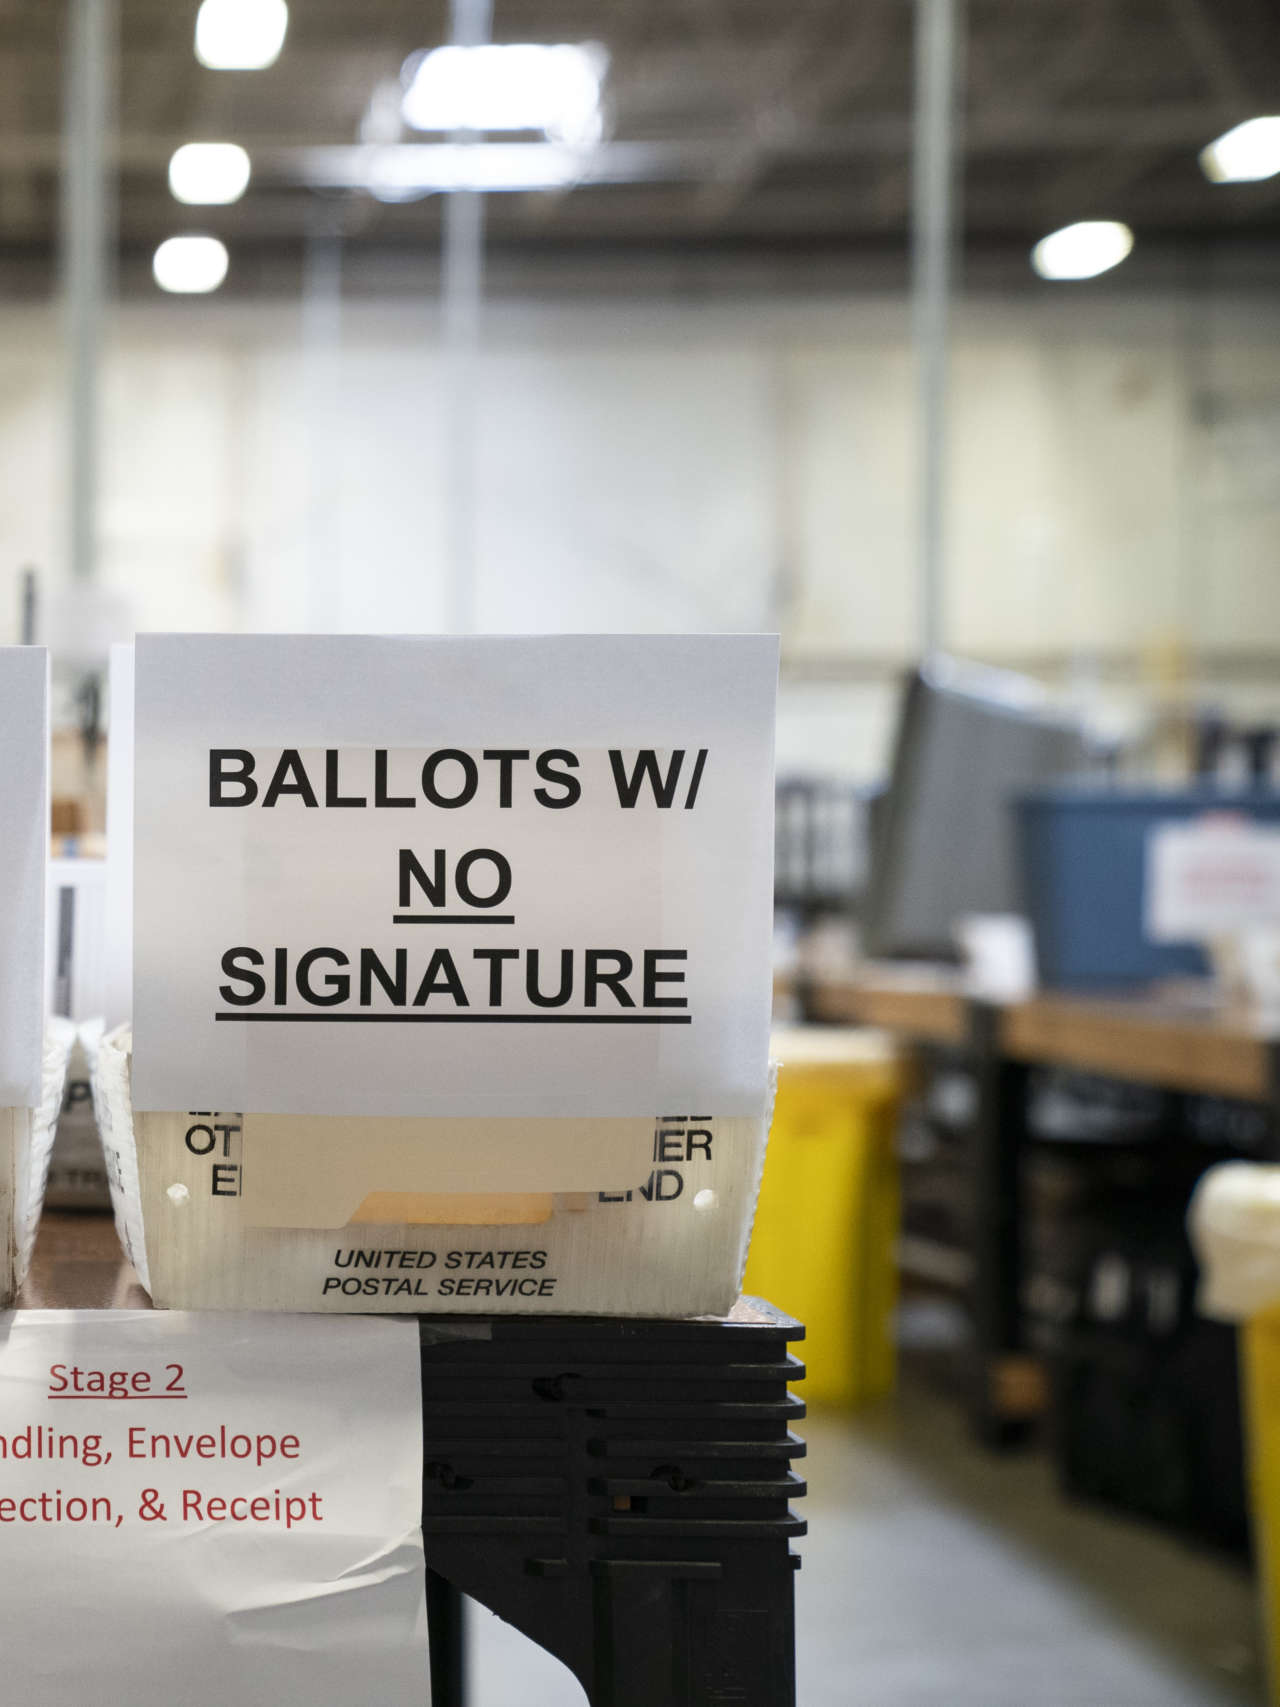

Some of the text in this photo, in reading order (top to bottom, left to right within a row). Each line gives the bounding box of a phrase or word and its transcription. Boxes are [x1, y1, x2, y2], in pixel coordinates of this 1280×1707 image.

[210, 749, 708, 809] BALLOTS W/
[399, 849, 511, 908] NO
[220, 947, 687, 1007] SIGNATURE
[653, 1129, 713, 1162] ER
[212, 1164, 242, 1196] E
[334, 1249, 548, 1270] UNITED STATES
[322, 1277, 557, 1297] POSTAL SERVICE
[48, 1363, 184, 1398] Stage 2
[129, 1425, 299, 1466] Envelope
[139, 1489, 166, 1520] &
[183, 1490, 322, 1528] Receipt
